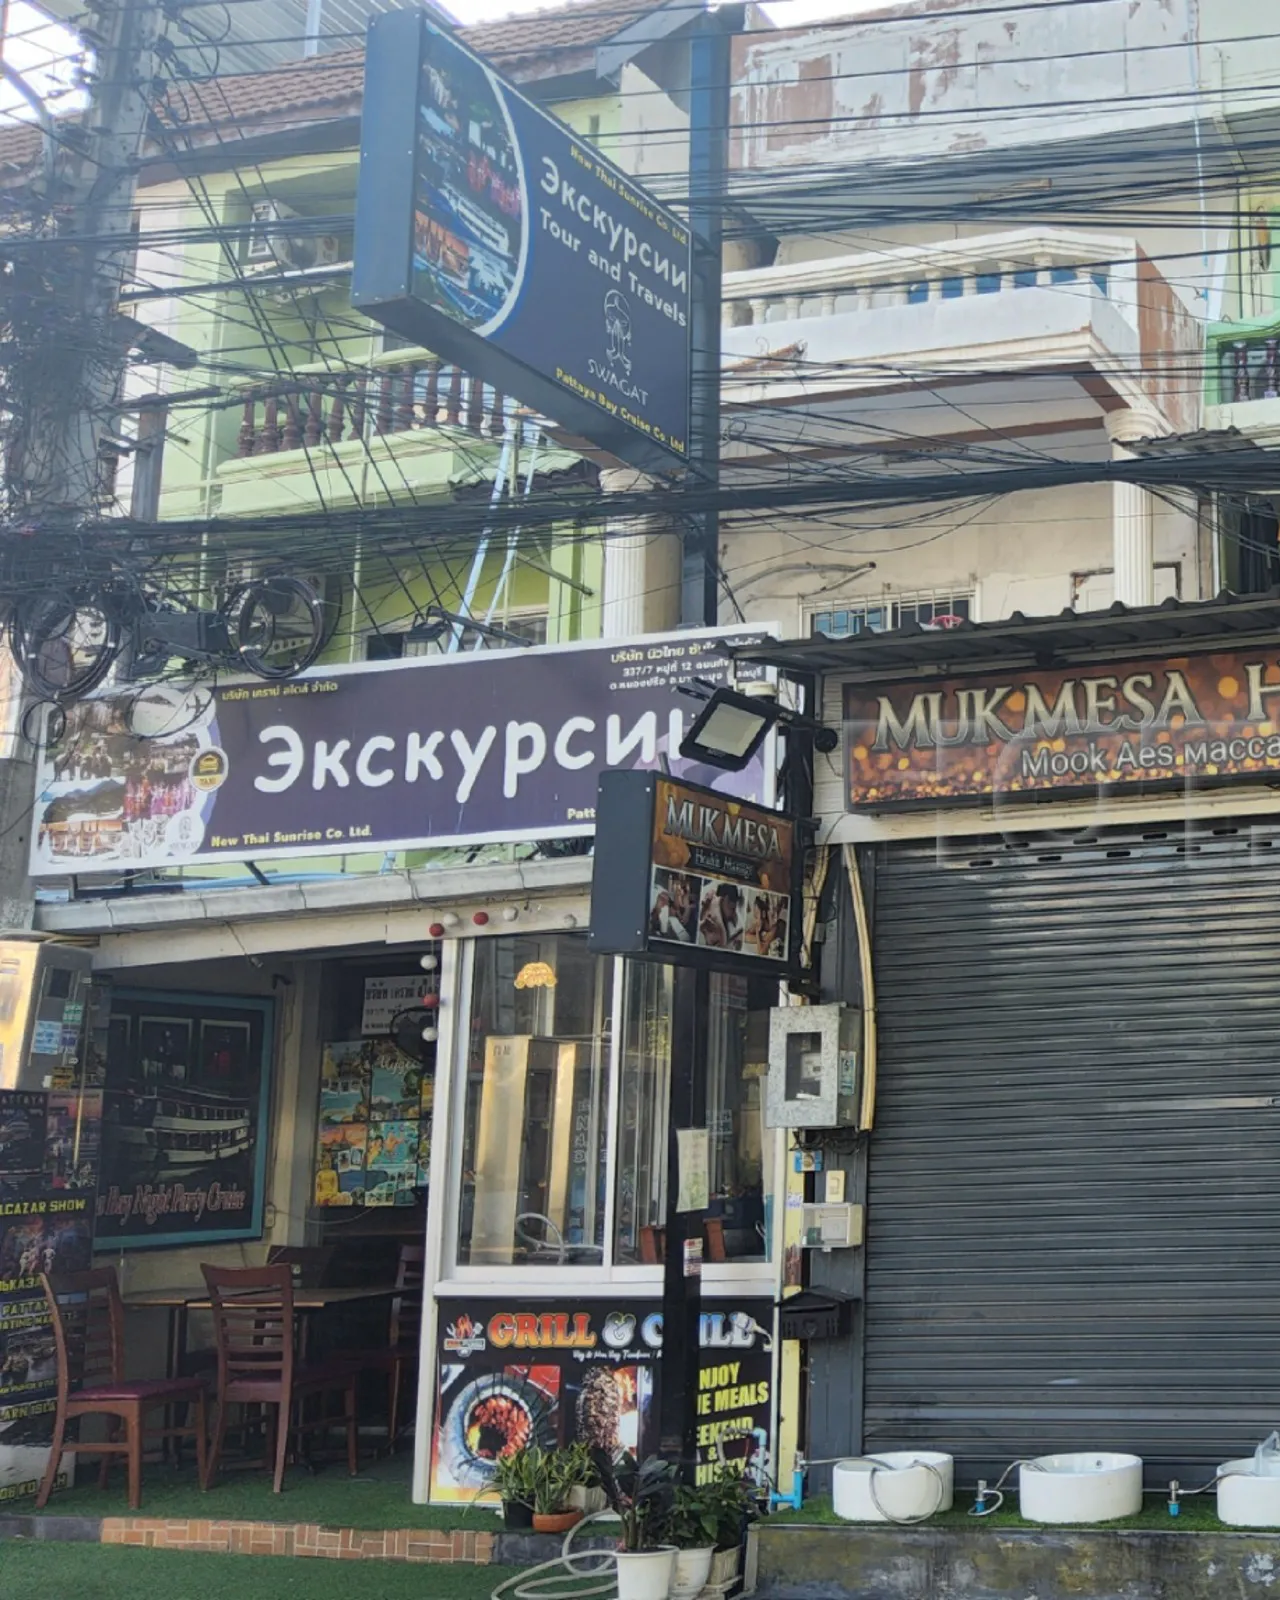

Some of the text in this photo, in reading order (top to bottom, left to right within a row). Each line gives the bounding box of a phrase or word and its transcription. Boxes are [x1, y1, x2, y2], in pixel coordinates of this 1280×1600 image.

[570, 145, 592, 170] New
[596, 166, 617, 190] Thai
[618, 184, 653, 219] Sunrise
[540, 156, 687, 293] Экскурсии
[539, 207, 687, 327] Tour and Travels
[587, 358, 649, 406] SWAGAT
[555, 367, 596, 400] Pattaya
[598, 392, 617, 415] Bay
[620, 407, 651, 433] Cruise
[611, 649, 644, 663] บริษัท
[622, 664, 653, 677] 337/7
[681, 661, 692, 671] 12
[254, 708, 686, 804] Экскурси
[1022, 742, 1107, 777] Mook
[1116, 741, 1173, 770] Aes
[566, 807, 597, 820] Patt
[211, 835, 238, 848] New
[243, 832, 269, 845] Thai
[273, 829, 322, 843] Sunrise
[349, 825, 373, 837] Ltd.
[0, 1201, 46, 1215] LCAZAR
[50, 1199, 86, 1212] SHOW
[487, 1312, 597, 1349] GRILL
[602, 1312, 637, 1349] &
[699, 1362, 741, 1391] NJOY
[714, 1381, 769, 1412] MEALS
[707, 1446, 718, 1461] &
